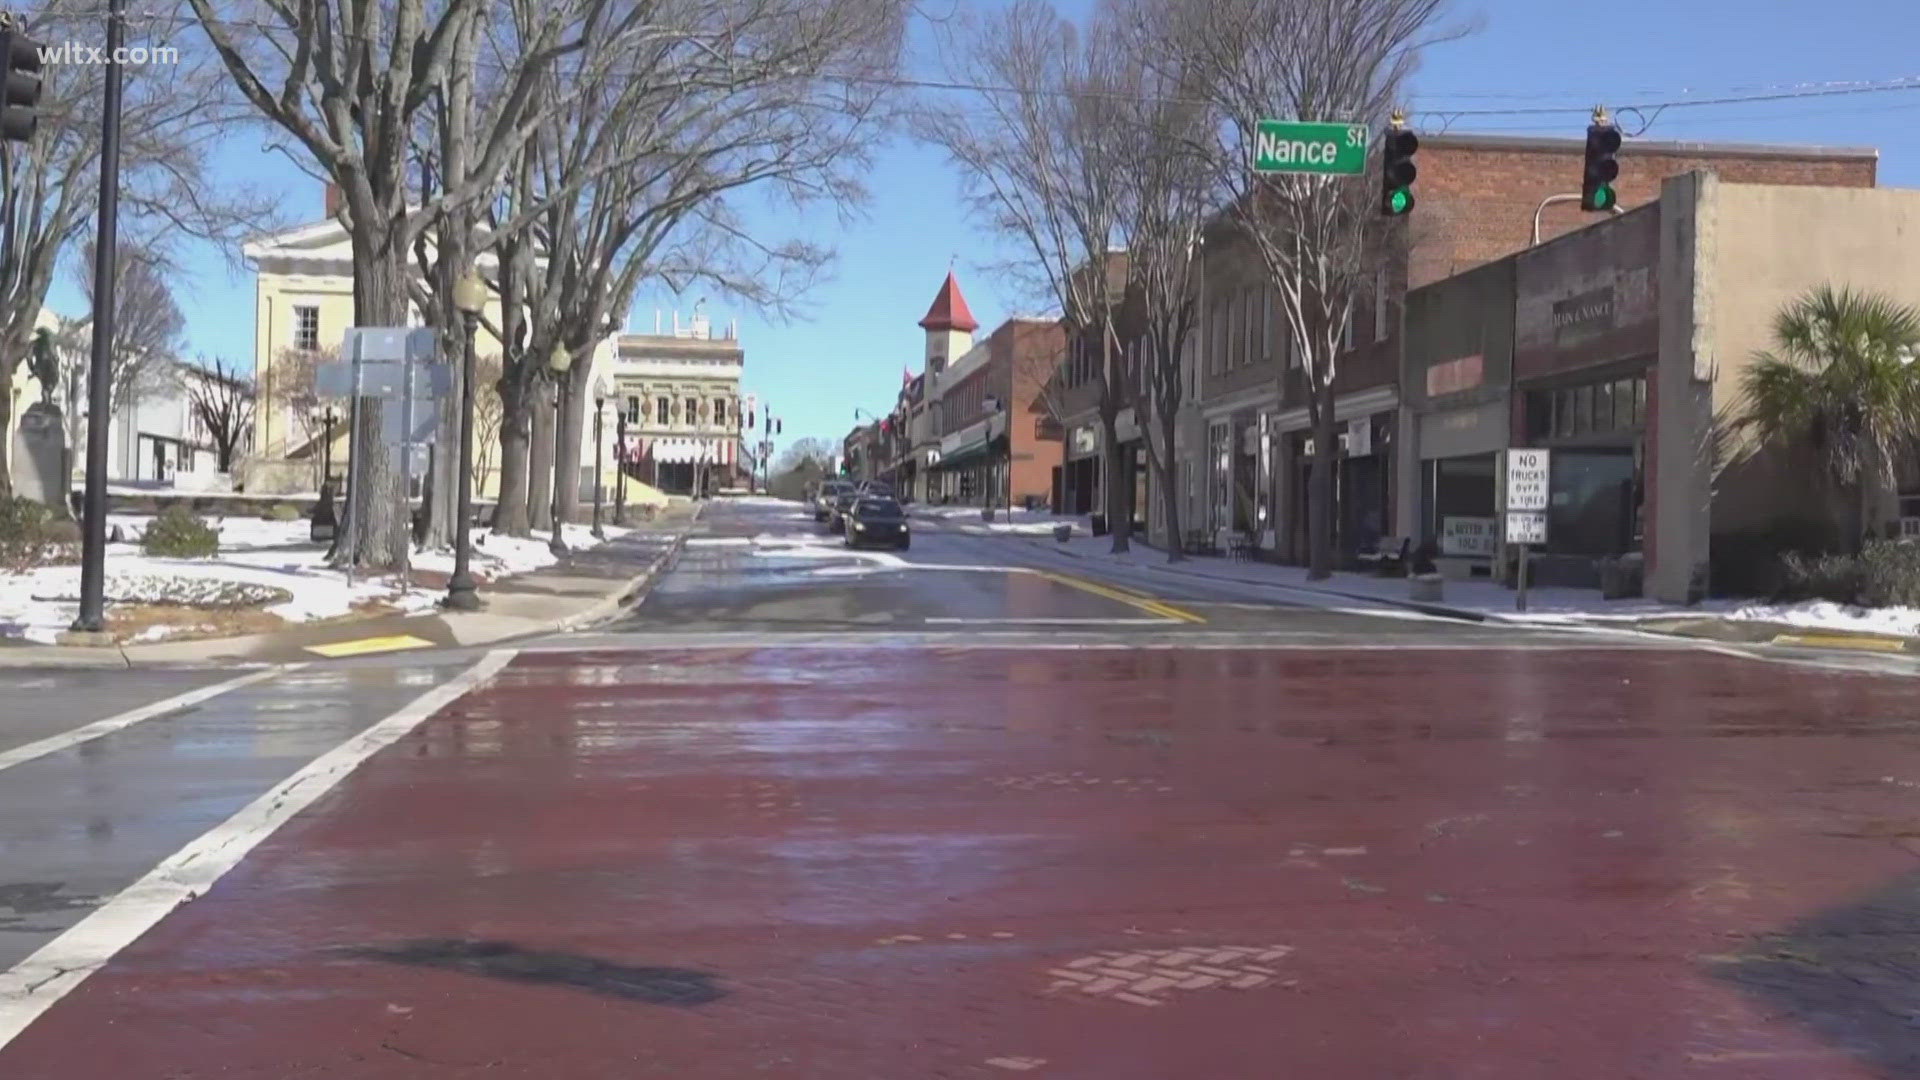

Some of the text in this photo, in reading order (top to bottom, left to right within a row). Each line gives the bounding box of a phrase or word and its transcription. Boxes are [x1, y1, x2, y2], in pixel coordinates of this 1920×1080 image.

[1257, 128, 1363, 165] Nance St
[1519, 455, 1537, 468] NO
[1511, 469, 1546, 481] TRUCKS
[1516, 485, 1540, 494] OVER
[1520, 495, 1544, 507] TIRES
